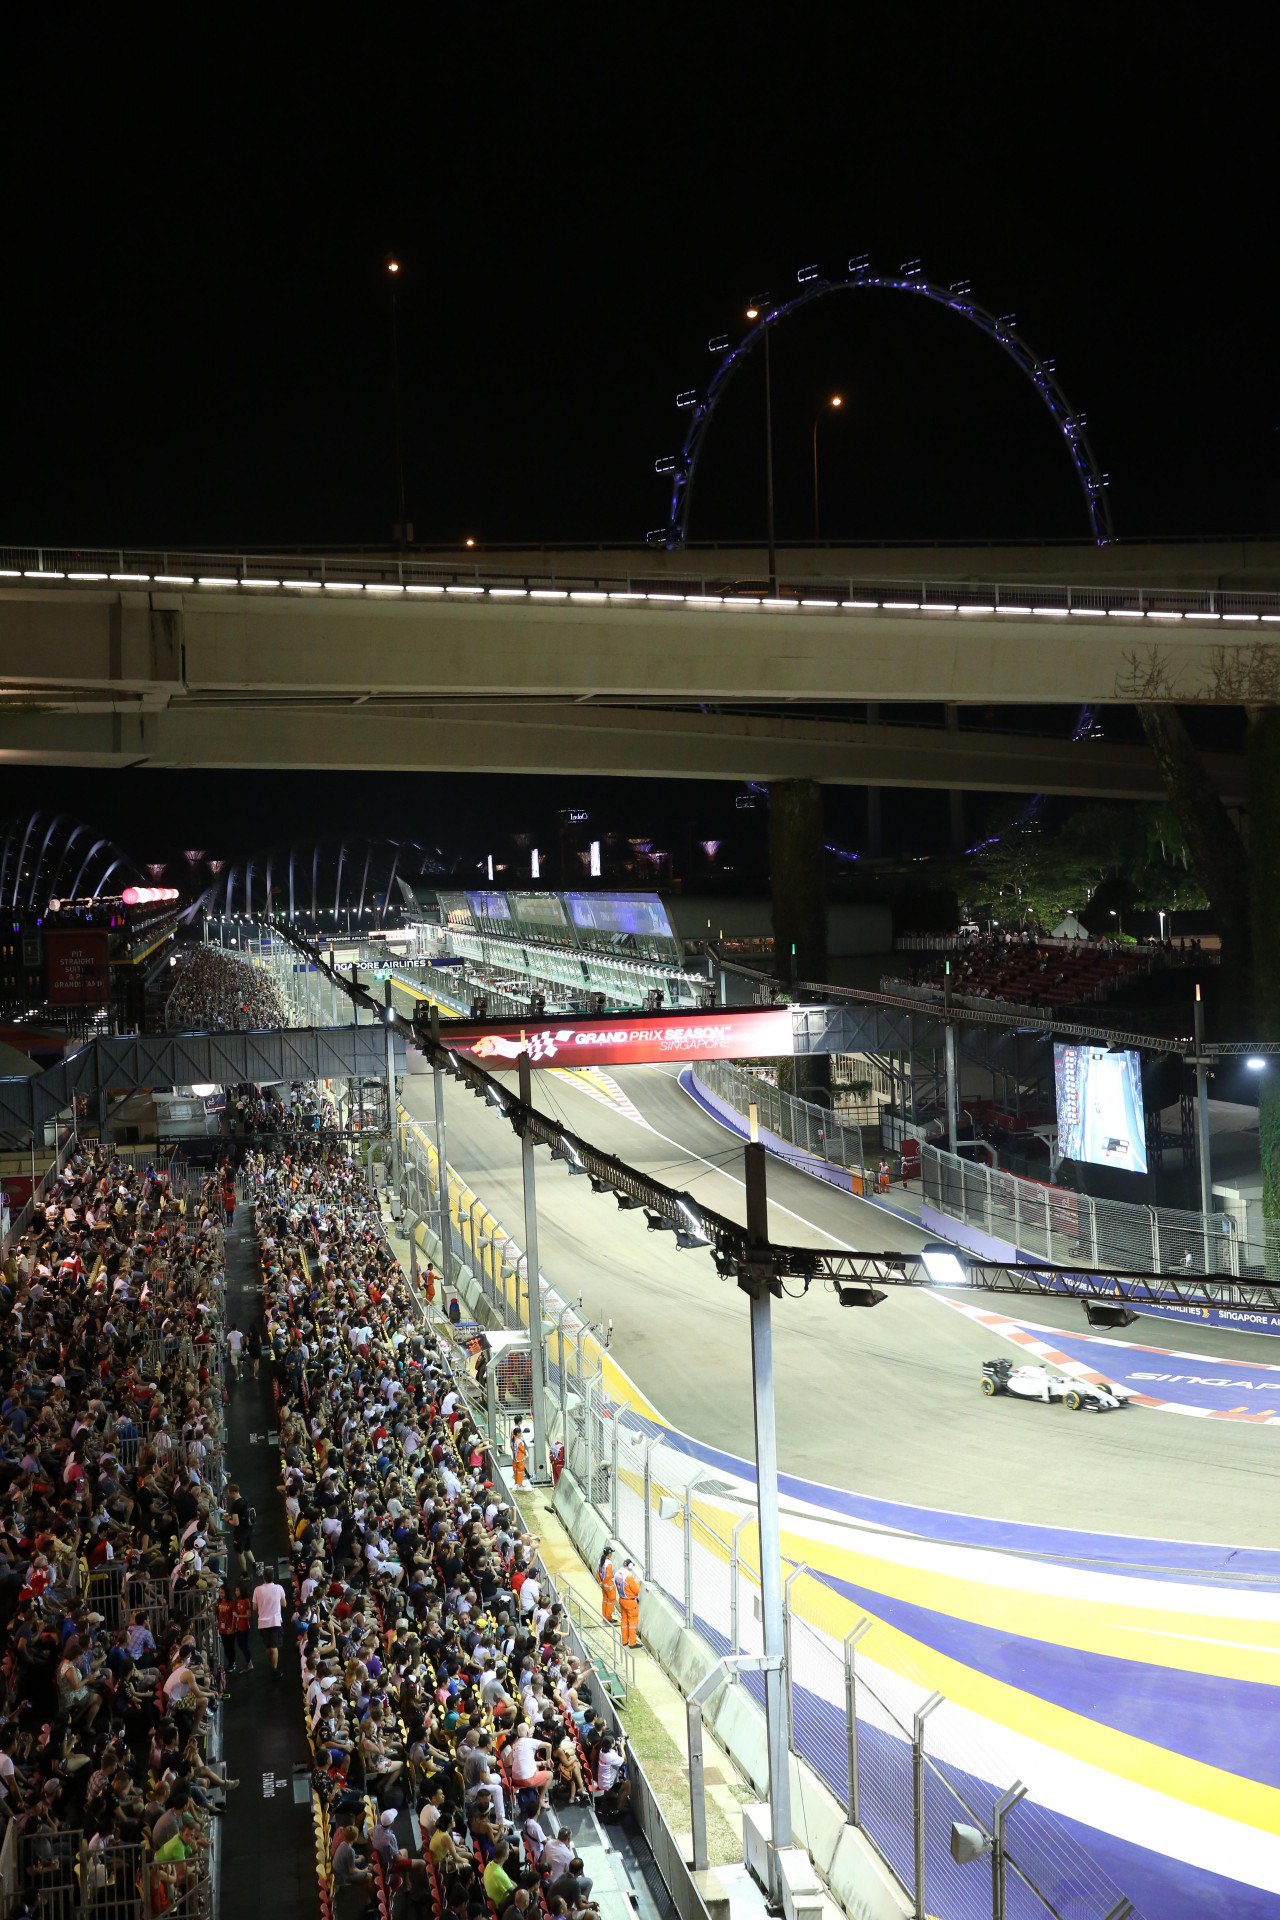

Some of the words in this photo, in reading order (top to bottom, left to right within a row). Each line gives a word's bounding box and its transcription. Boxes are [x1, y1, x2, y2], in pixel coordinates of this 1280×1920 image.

[60, 958, 95, 966] STRAIGHT
[382, 960, 426, 968] AIRLINES
[54, 980, 103, 988] GRANDAND
[575, 1031, 628, 1044] GRAND
[628, 1030, 663, 1041] PRIX
[659, 1038, 730, 1051] SINGAPORE
[1218, 1310, 1268, 1325] SINGAPORE
[262, 1772, 275, 1798] STANDING
[275, 1779, 288, 1787] NO
